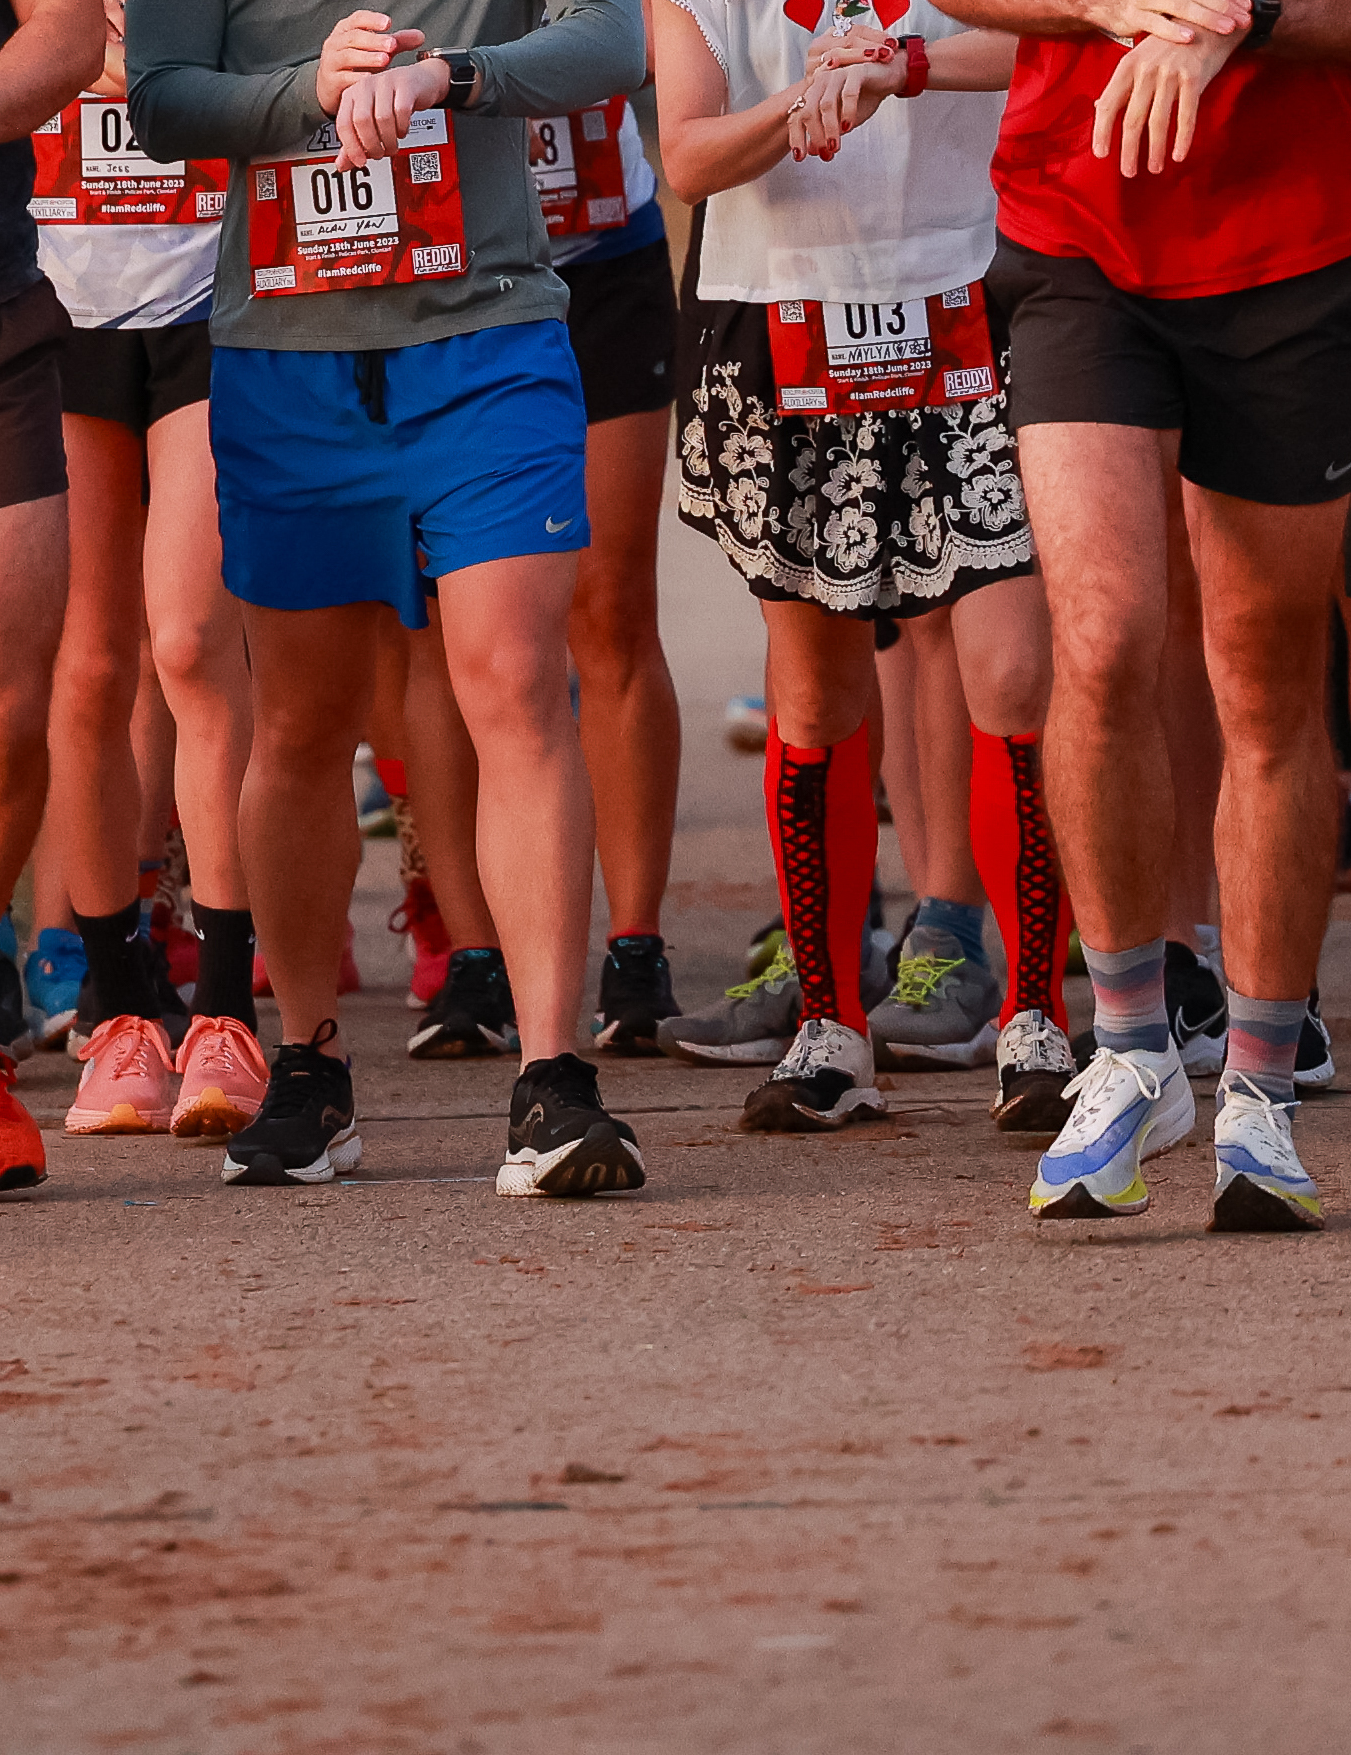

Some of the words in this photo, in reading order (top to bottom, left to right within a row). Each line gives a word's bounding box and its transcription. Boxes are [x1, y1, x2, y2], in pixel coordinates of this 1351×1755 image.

[306, 121, 342, 152] 21
[80, 180, 115, 191] Sunday
[138, 180, 161, 189] June
[162, 179, 185, 188] 2023
[310, 166, 373, 215] 016
[198, 194, 223, 211] RED
[297, 243, 329, 255] Sunday
[329, 240, 351, 252] 18th
[352, 239, 375, 250] June
[376, 236, 399, 247] 2023
[414, 246, 458, 268] REDDY
[317, 262, 382, 279] #IamRedcliffe
[848, 344, 891, 363] NAYLYA
[828, 367, 862, 378] Sunday
[863, 365, 885, 375] 18th
[886, 363, 909, 373] June
[909, 360, 932, 370] 2023
[946, 369, 987, 390] REDDY
[850, 386, 915, 401] #IamRedcliffe
